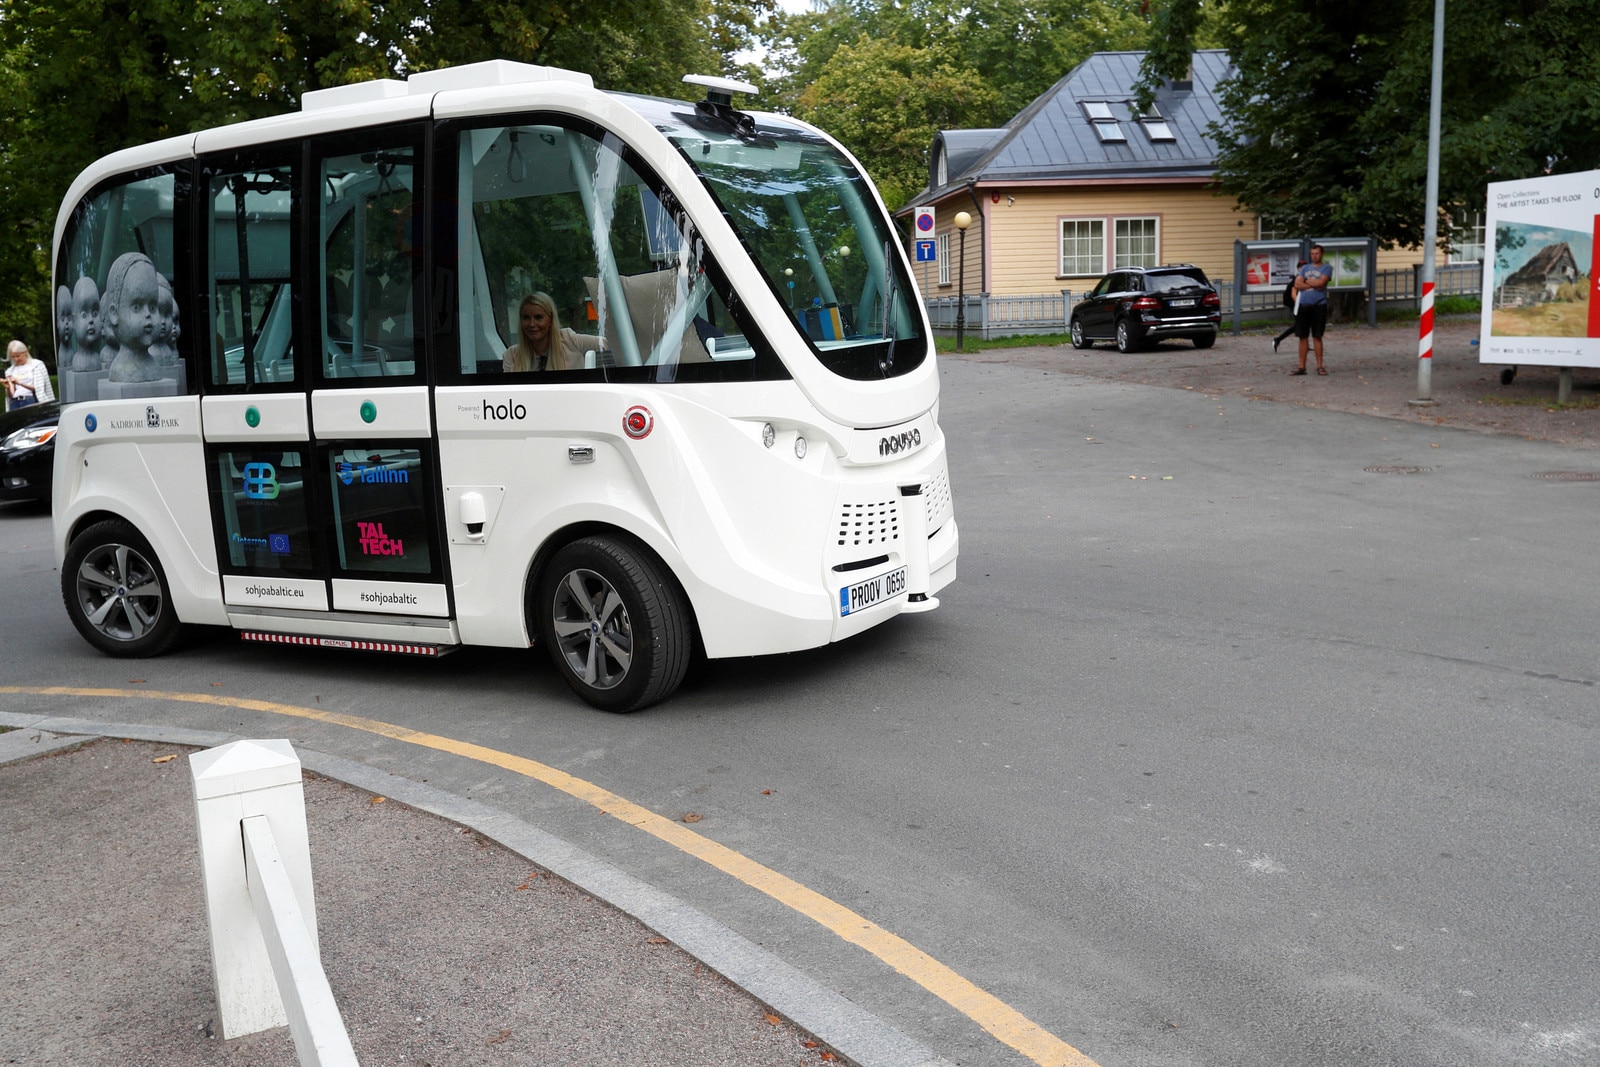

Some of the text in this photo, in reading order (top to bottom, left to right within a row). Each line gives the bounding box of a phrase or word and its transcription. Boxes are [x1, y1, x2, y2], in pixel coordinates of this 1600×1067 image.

[1512, 190, 1540, 199] Collections
[1531, 197, 1550, 205] TAKES
[1562, 194, 1581, 202] FLOOR
[457, 404, 480, 412] Powered
[483, 398, 526, 420] holo
[110, 418, 180, 429] KADRIORU PARK
[356, 465, 409, 483] Tallinn
[357, 522, 388, 539] TAL
[359, 538, 404, 556] TECH
[886, 569, 906, 596] 0658
[245, 584, 305, 598] sohjoabaltic.eu
[360, 591, 418, 606] #sohjoabaltic
[841, 604, 849, 613] EST
